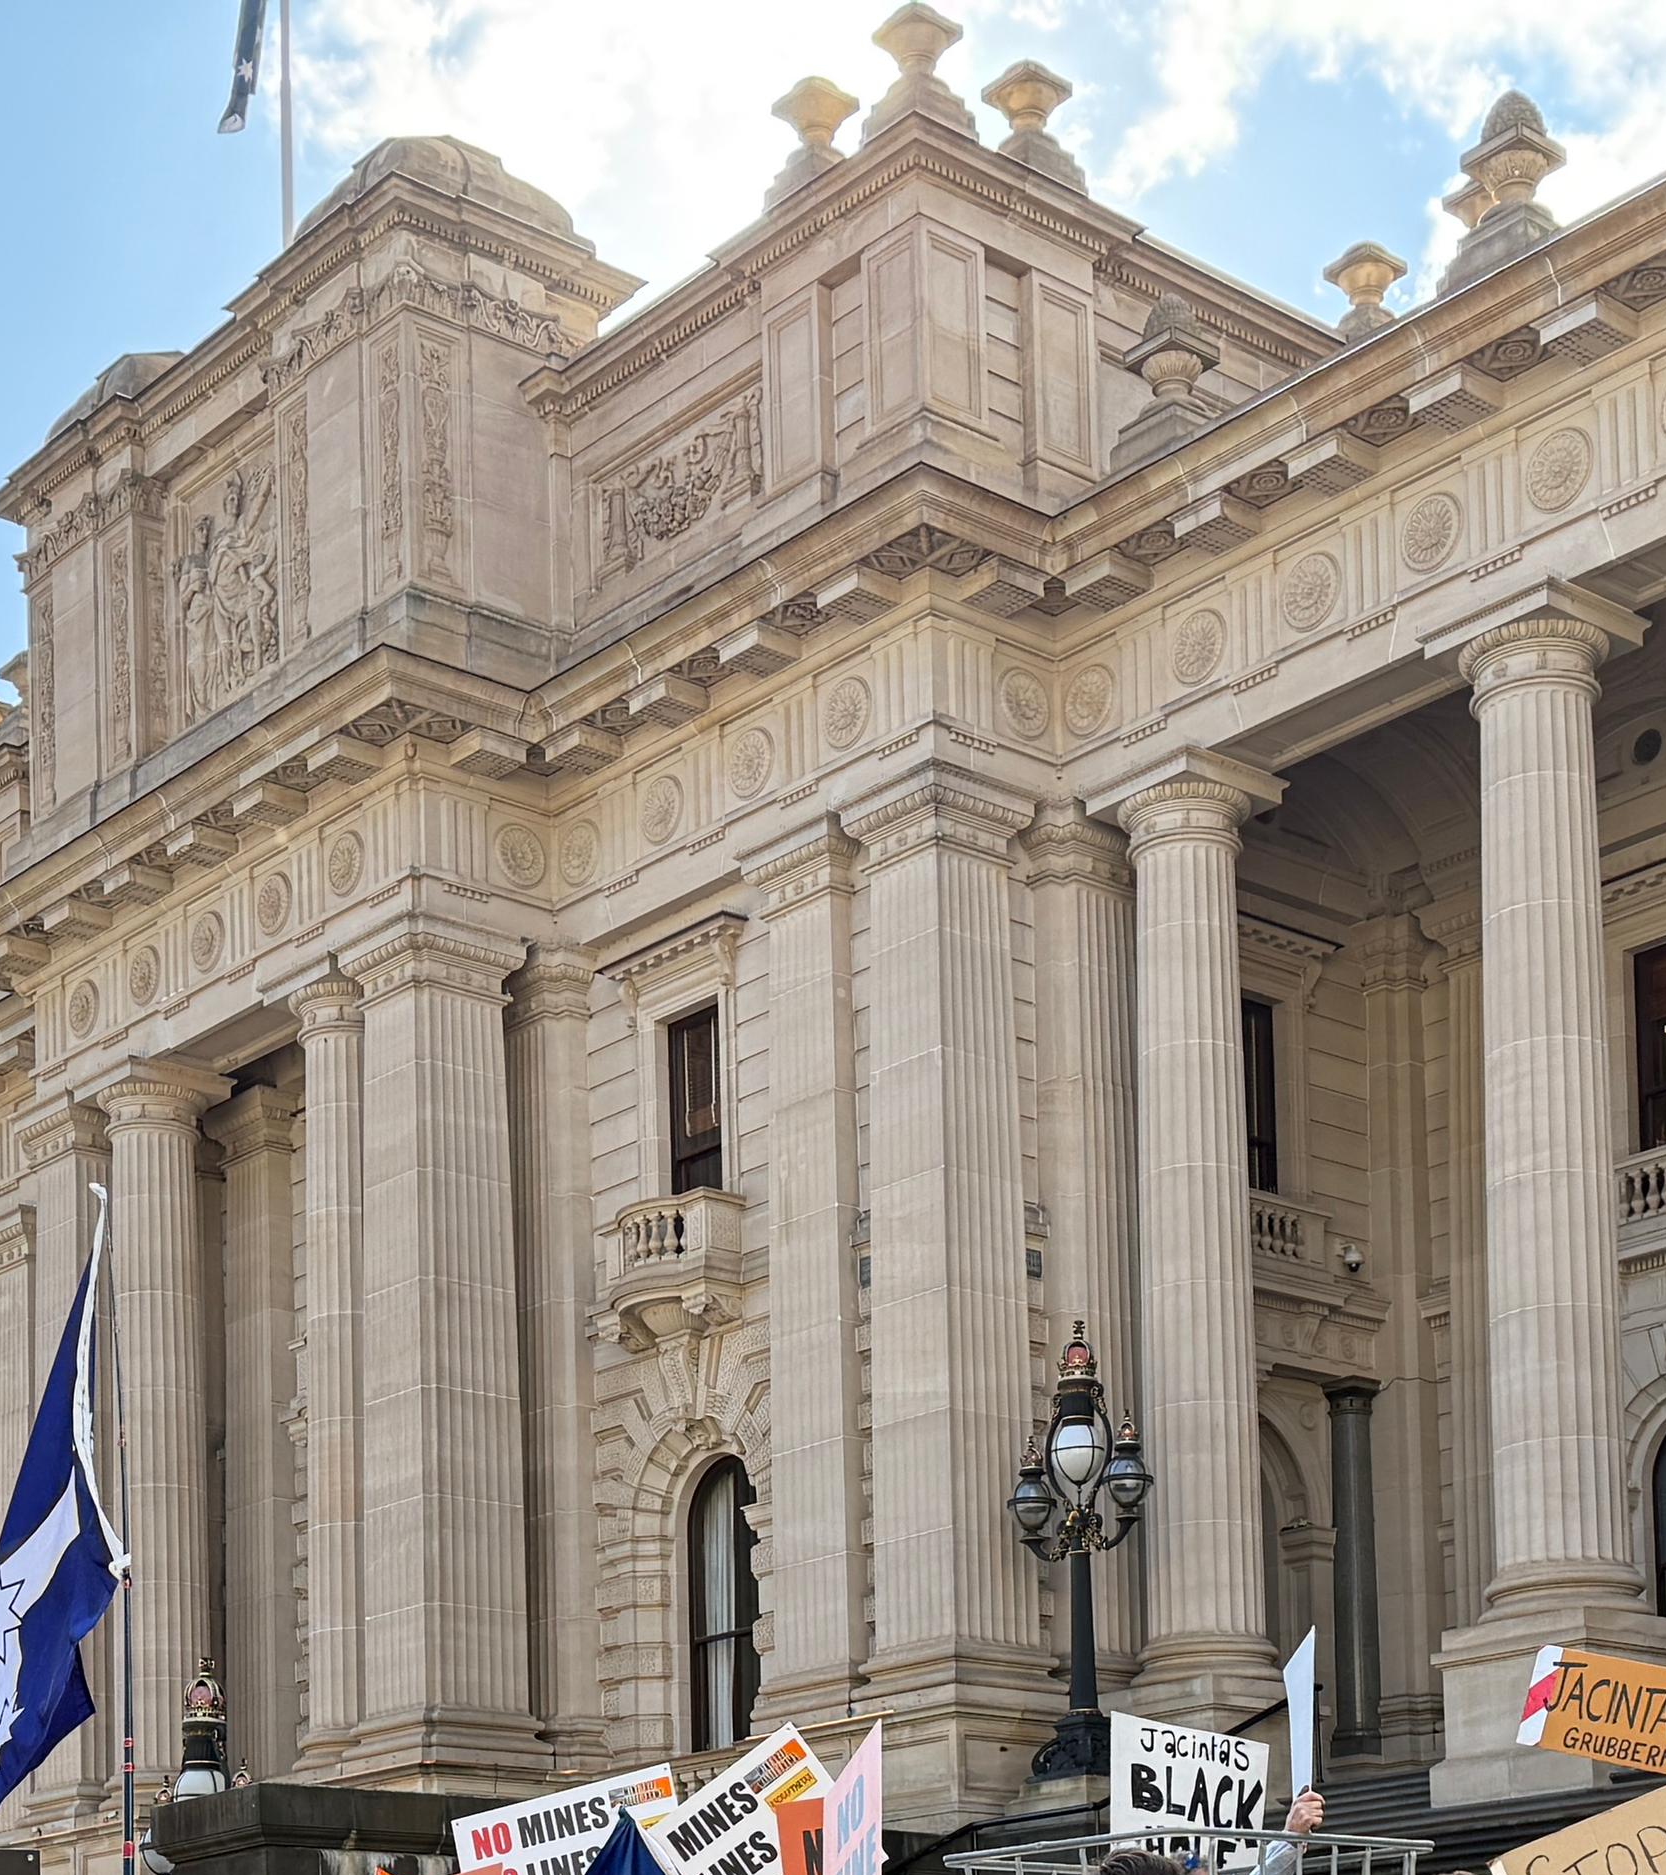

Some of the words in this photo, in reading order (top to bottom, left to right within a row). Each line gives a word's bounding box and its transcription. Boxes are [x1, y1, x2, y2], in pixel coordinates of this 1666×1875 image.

[471, 1821, 513, 1861] NO
[516, 1796, 610, 1849] MINES
[666, 1781, 759, 1862] MINES
[837, 1773, 865, 1854] NO
[1131, 1763, 1264, 1849] BLACK
